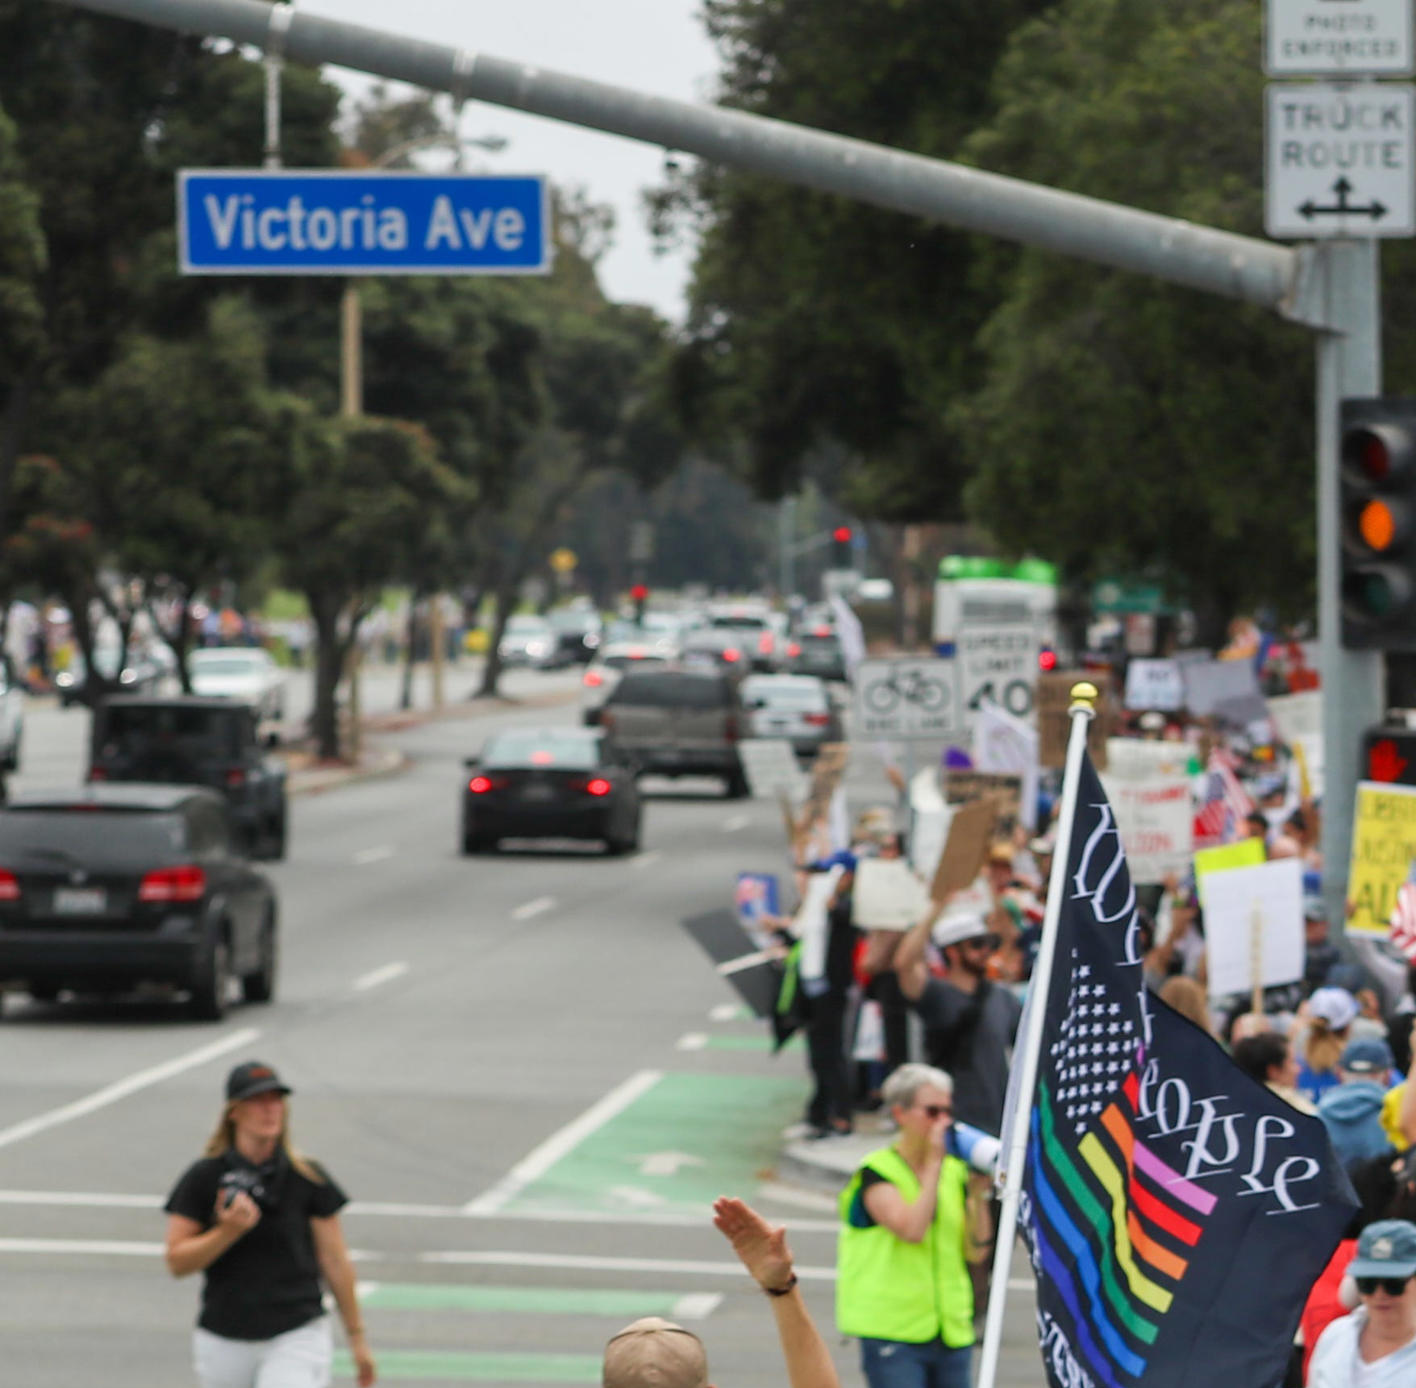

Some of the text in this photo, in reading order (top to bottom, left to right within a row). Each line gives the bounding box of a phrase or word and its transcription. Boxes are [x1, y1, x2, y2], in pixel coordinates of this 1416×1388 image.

[1283, 103, 1402, 131] TRUCK
[1281, 140, 1402, 169] ROUTE
[203, 195, 526, 252] Victoria Ave
